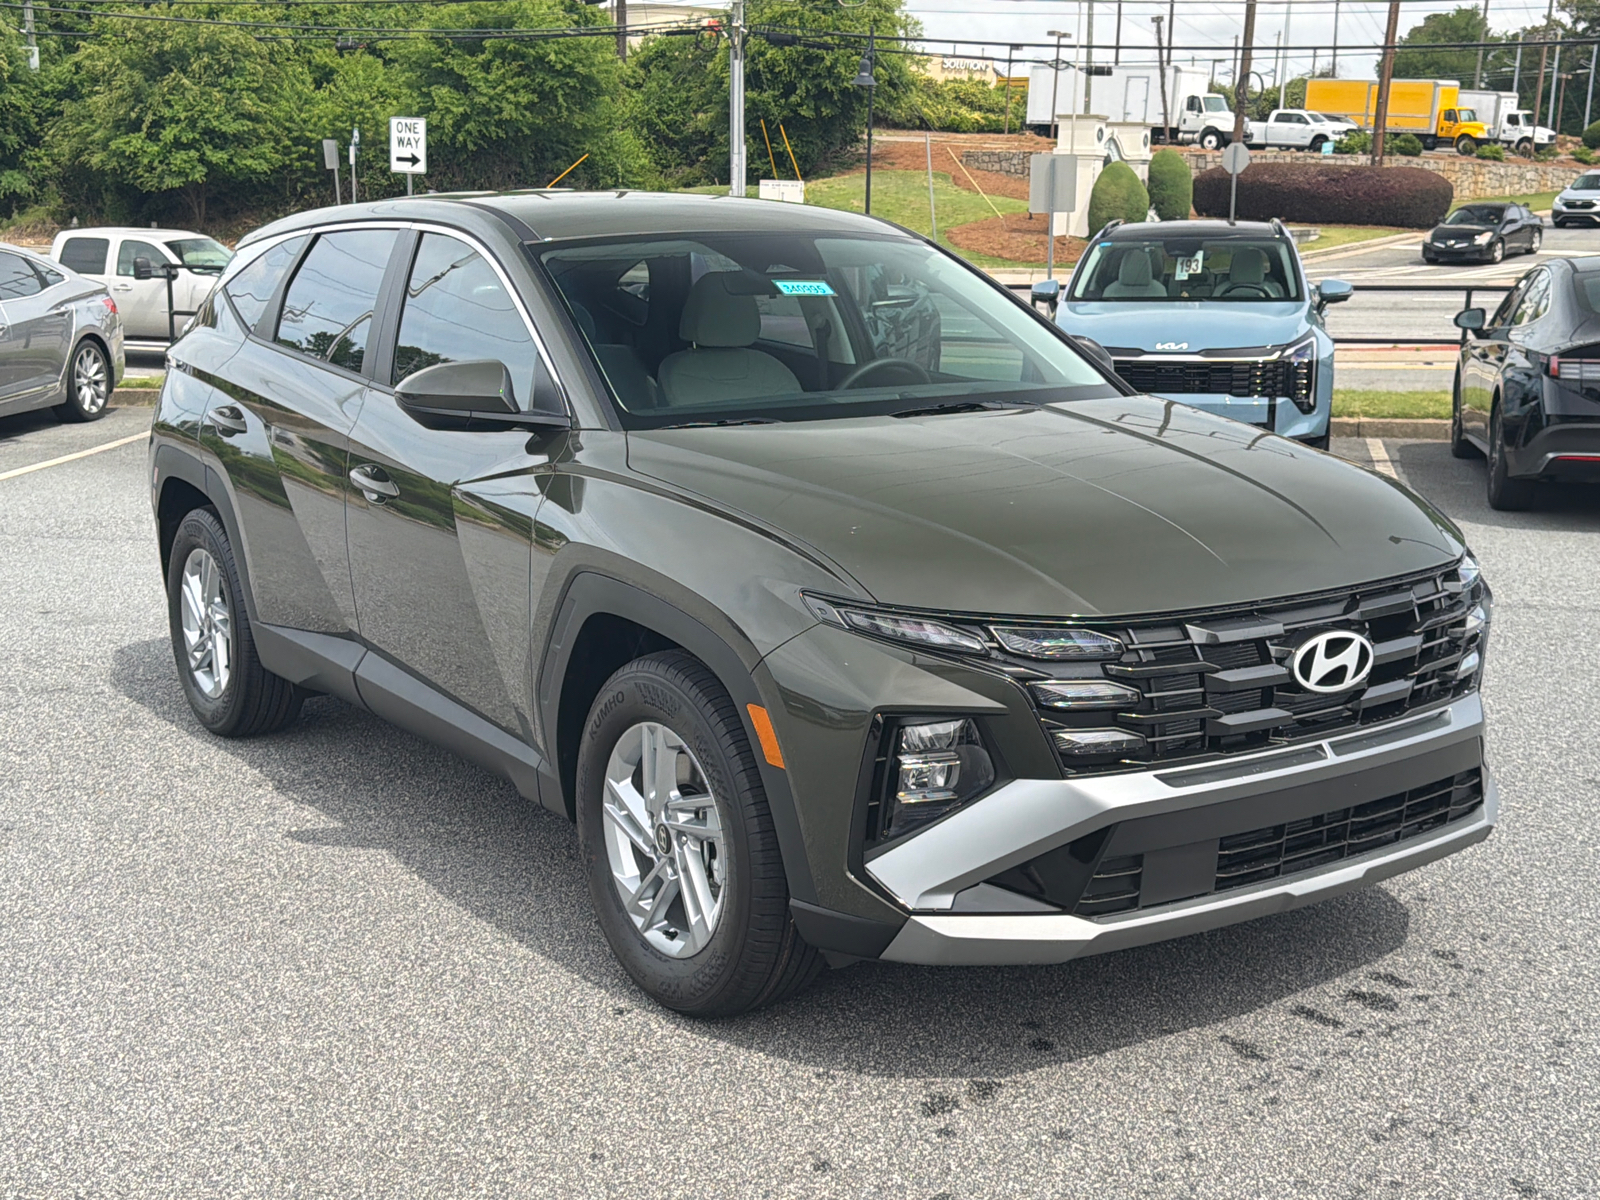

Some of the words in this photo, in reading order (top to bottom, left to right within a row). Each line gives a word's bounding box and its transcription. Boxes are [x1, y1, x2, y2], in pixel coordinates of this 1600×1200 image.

[396, 121, 420, 134] ONE
[396, 136, 421, 149] WAY
[1180, 259, 1200, 273] 193
[588, 690, 626, 741] KUMHO
